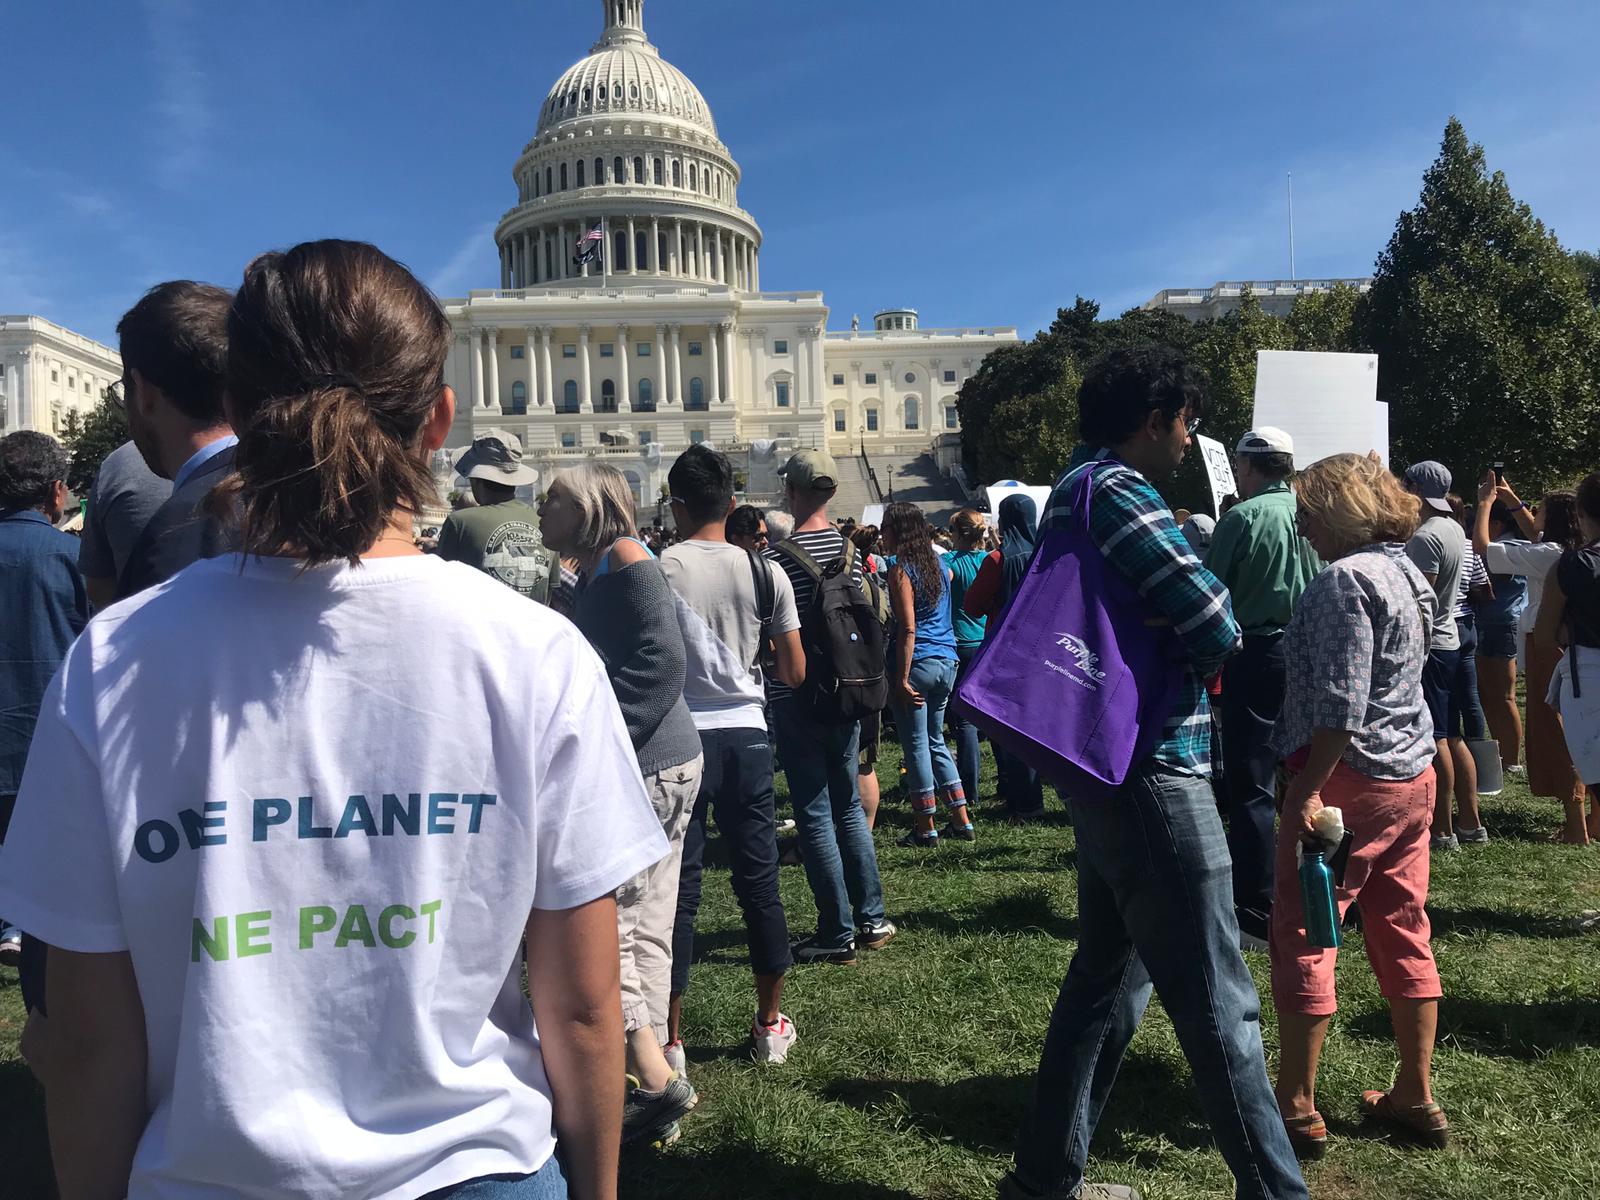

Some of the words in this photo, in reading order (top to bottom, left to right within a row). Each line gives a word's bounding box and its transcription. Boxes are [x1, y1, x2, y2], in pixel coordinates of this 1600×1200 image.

[1203, 446, 1229, 471] VOTE
[1056, 637, 1099, 663] Purple
[1044, 660, 1097, 691] purplelinemd.com
[134, 801, 227, 863] ONE
[252, 793, 497, 842] PLANET
[191, 910, 272, 962] NE
[299, 899, 442, 949] PACT
